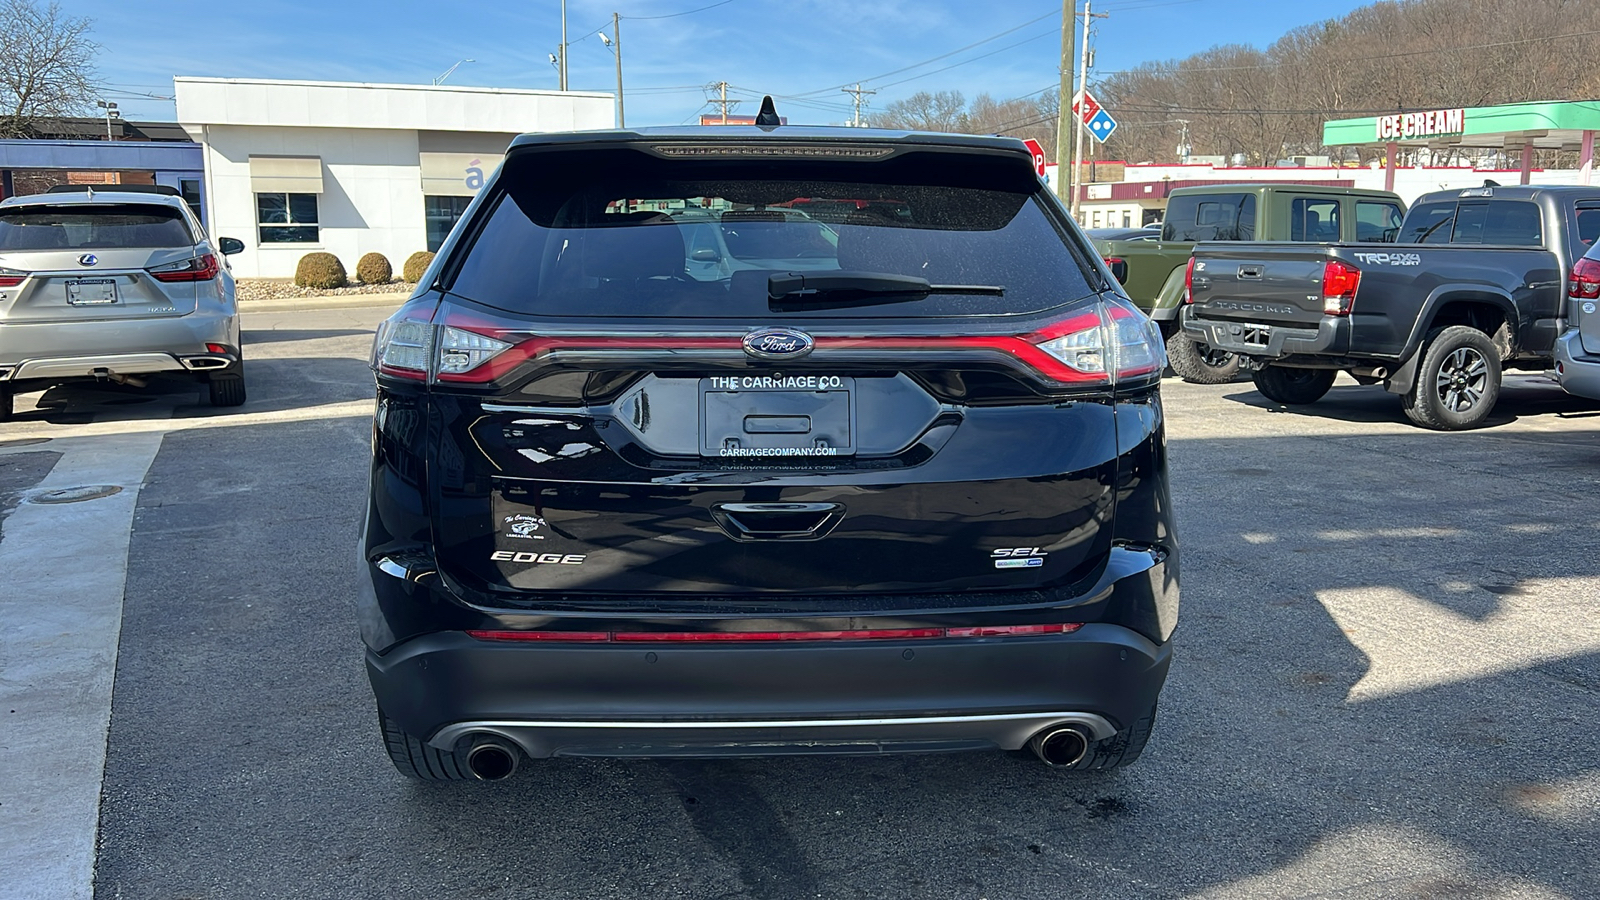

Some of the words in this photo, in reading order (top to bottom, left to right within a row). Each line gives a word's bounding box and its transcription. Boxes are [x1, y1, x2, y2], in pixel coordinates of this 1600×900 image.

[1376, 115, 1402, 139] ICE
[1404, 109, 1464, 137] CREAM
[1354, 252, 1390, 265] TRD
[1217, 301, 1293, 314] TACOMA
[760, 335, 796, 351] Ford
[710, 376, 739, 389] THE
[742, 376, 816, 388] CARRIAGE
[819, 376, 844, 389] CO.
[719, 448, 837, 457] CARRIAGECOMPANY.COM
[490, 551, 587, 565] EDGE
[990, 547, 1048, 557] SEL
